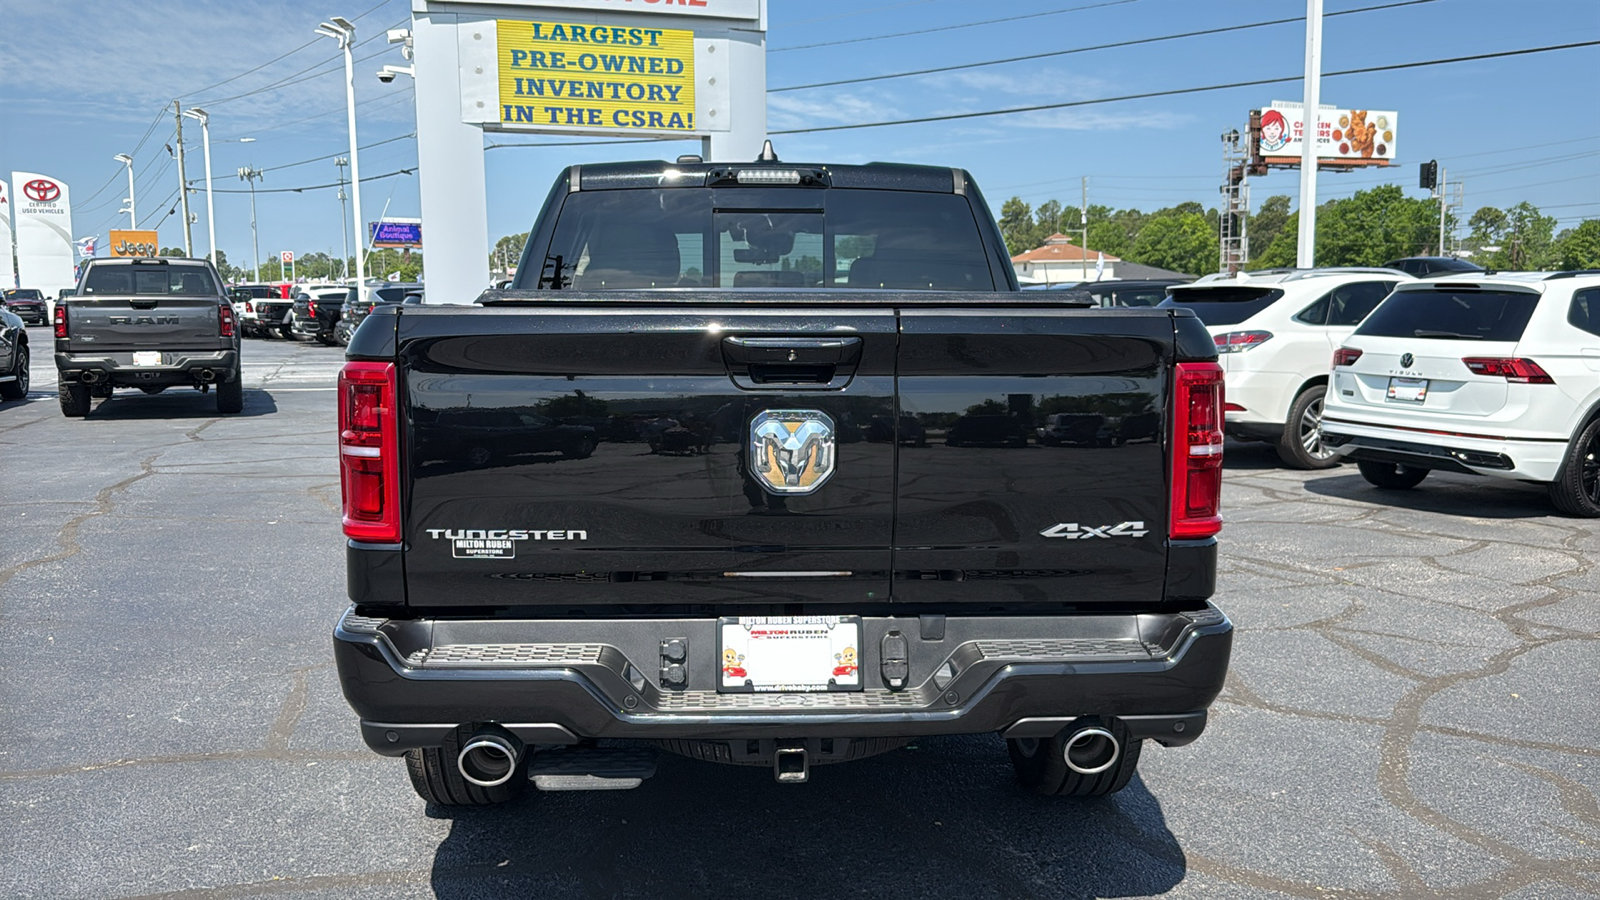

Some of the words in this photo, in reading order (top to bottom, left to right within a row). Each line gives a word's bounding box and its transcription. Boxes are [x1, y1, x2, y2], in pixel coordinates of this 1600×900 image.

[531, 22, 663, 47] LARGEST
[510, 49, 684, 75] PRE-OWNED
[514, 77, 683, 102] INVENTORY
[502, 104, 535, 123] IN
[544, 106, 603, 126] THE
[612, 109, 694, 129] CSRA!
[379, 231, 413, 241] Boutique
[115, 240, 157, 258] Jeep
[109, 315, 179, 325] RAM
[425, 528, 588, 541] TUNGSTEN
[456, 540, 485, 549] MILTON
[485, 540, 512, 549] RUBEN
[738, 616, 767, 625] MILTON
[767, 616, 792, 625] RUBEN
